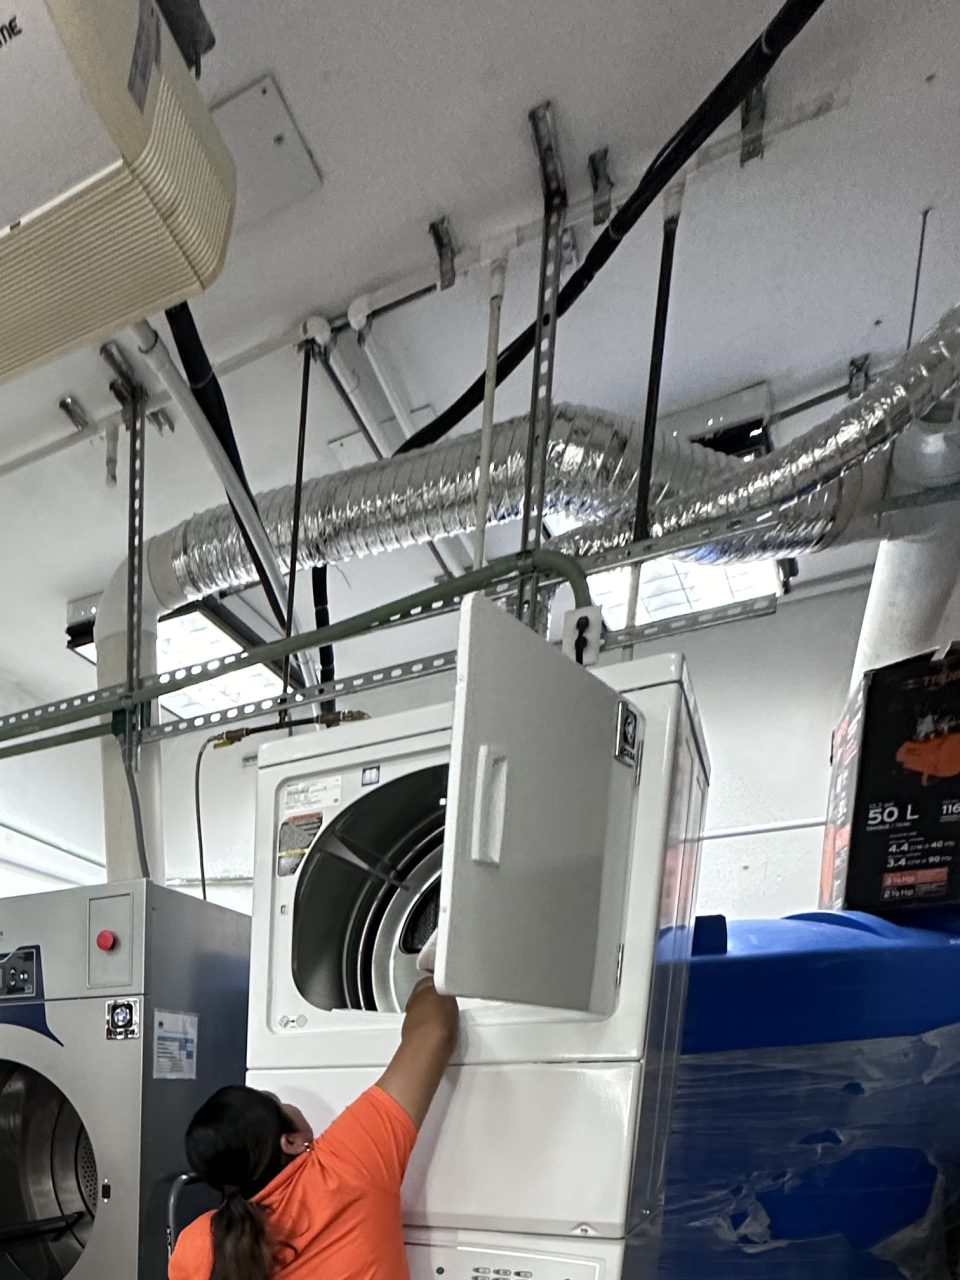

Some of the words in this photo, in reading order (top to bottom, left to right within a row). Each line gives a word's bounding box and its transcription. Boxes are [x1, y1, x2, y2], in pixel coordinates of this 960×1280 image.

[867, 806, 899, 825] 50
[906, 803, 919, 820] L
[888, 842, 909, 853] 4.4
[930, 840, 944, 848] 40
[886, 857, 907, 868] 3.4
